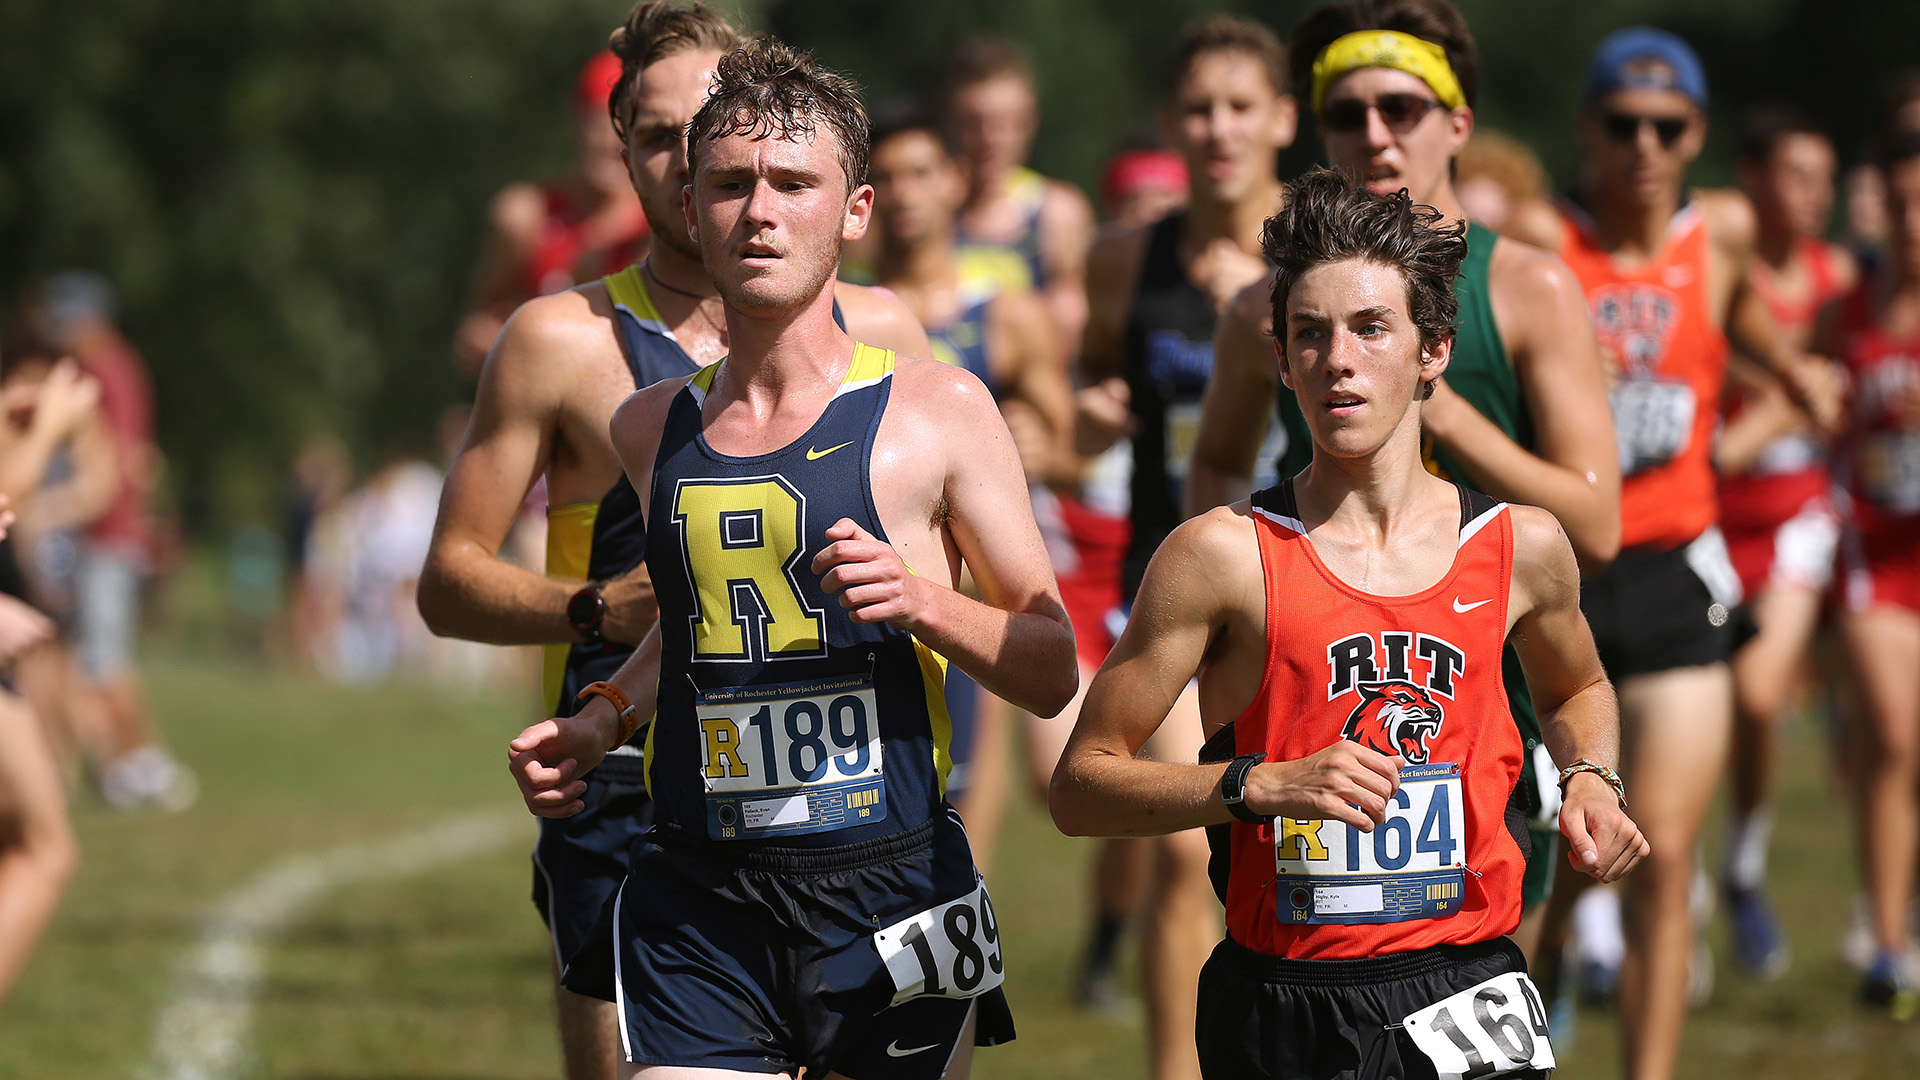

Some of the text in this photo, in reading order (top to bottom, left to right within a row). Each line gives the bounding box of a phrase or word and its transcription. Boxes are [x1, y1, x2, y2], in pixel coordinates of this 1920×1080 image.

[672, 474, 828, 662] R
[1327, 631, 1465, 701] RIT
[705, 691, 735, 700] University
[744, 688, 777, 698] Rochester
[778, 685, 822, 696] Yellowjacket
[823, 679, 863, 690] Invitational
[700, 694, 870, 786] R 189
[1412, 767, 1450, 777] Invitational
[721, 827, 736, 838] 189
[858, 808, 870, 818] 189
[1345, 784, 1456, 871] 164
[1292, 910, 1308, 921] 164
[1436, 902, 1448, 910] 164
[899, 887, 1003, 995] 189
[1429, 978, 1550, 1080] 164
